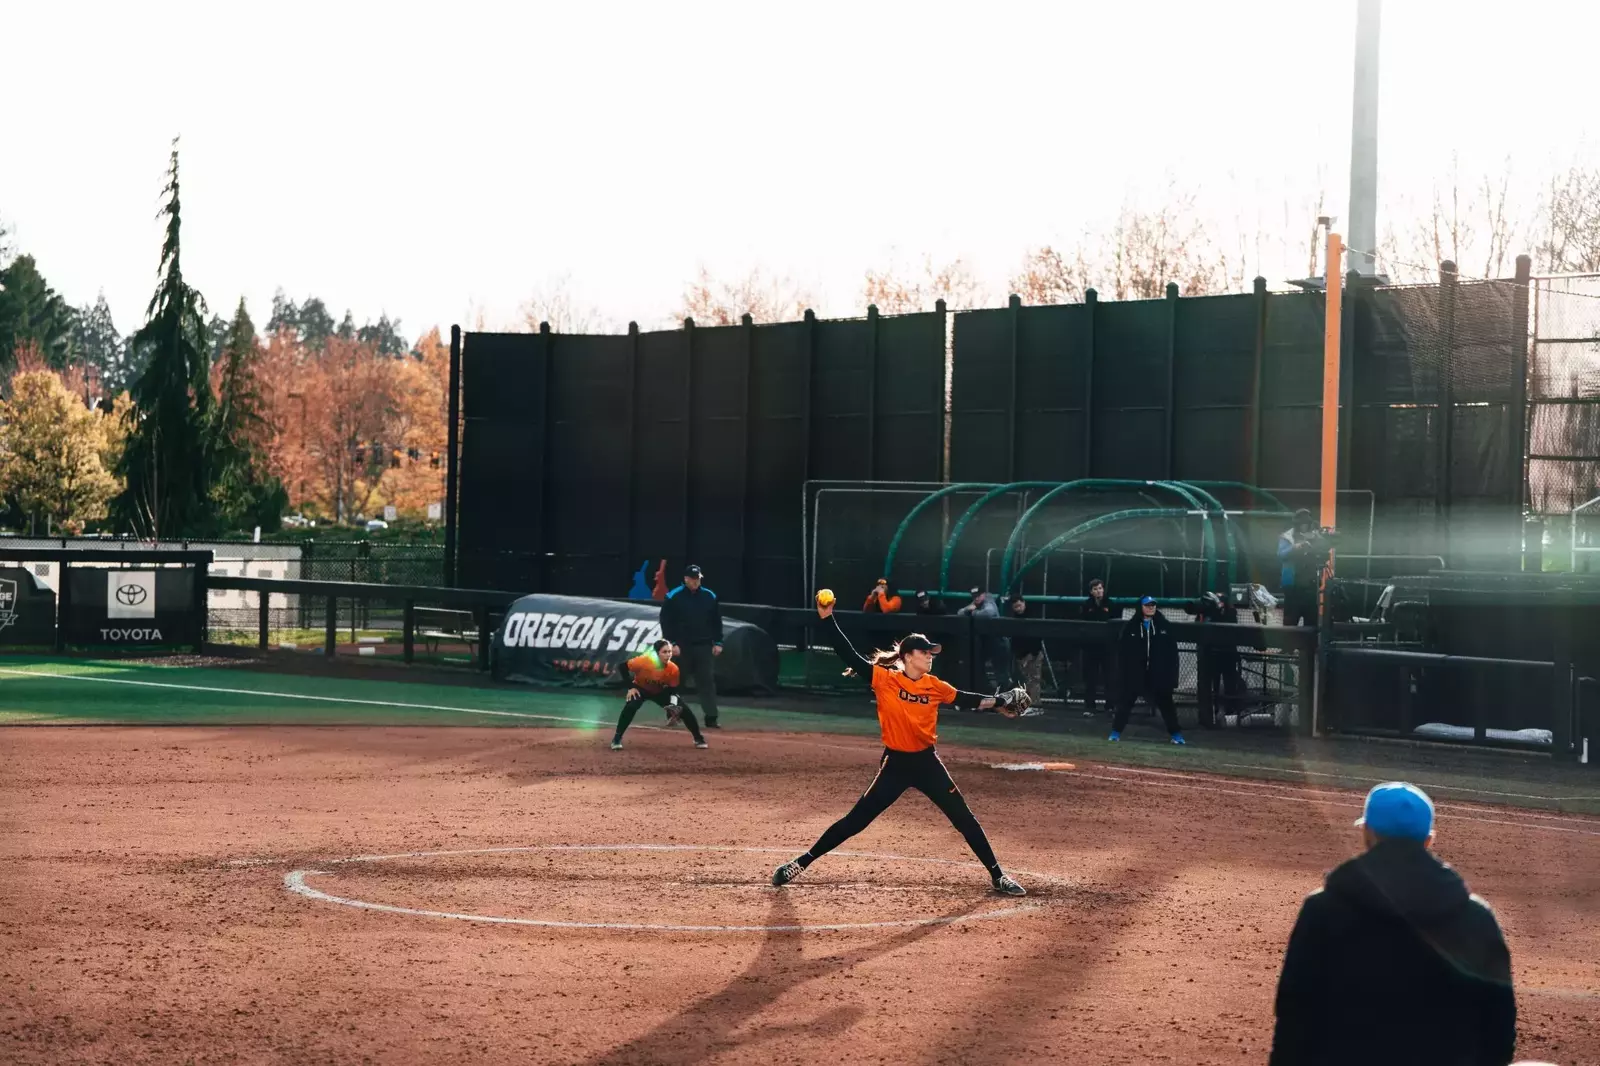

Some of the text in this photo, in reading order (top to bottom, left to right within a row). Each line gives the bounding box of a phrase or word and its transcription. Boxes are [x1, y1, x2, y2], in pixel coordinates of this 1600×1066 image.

[100, 628, 162, 640] TOYOTA
[503, 612, 662, 652] OREGON STA
